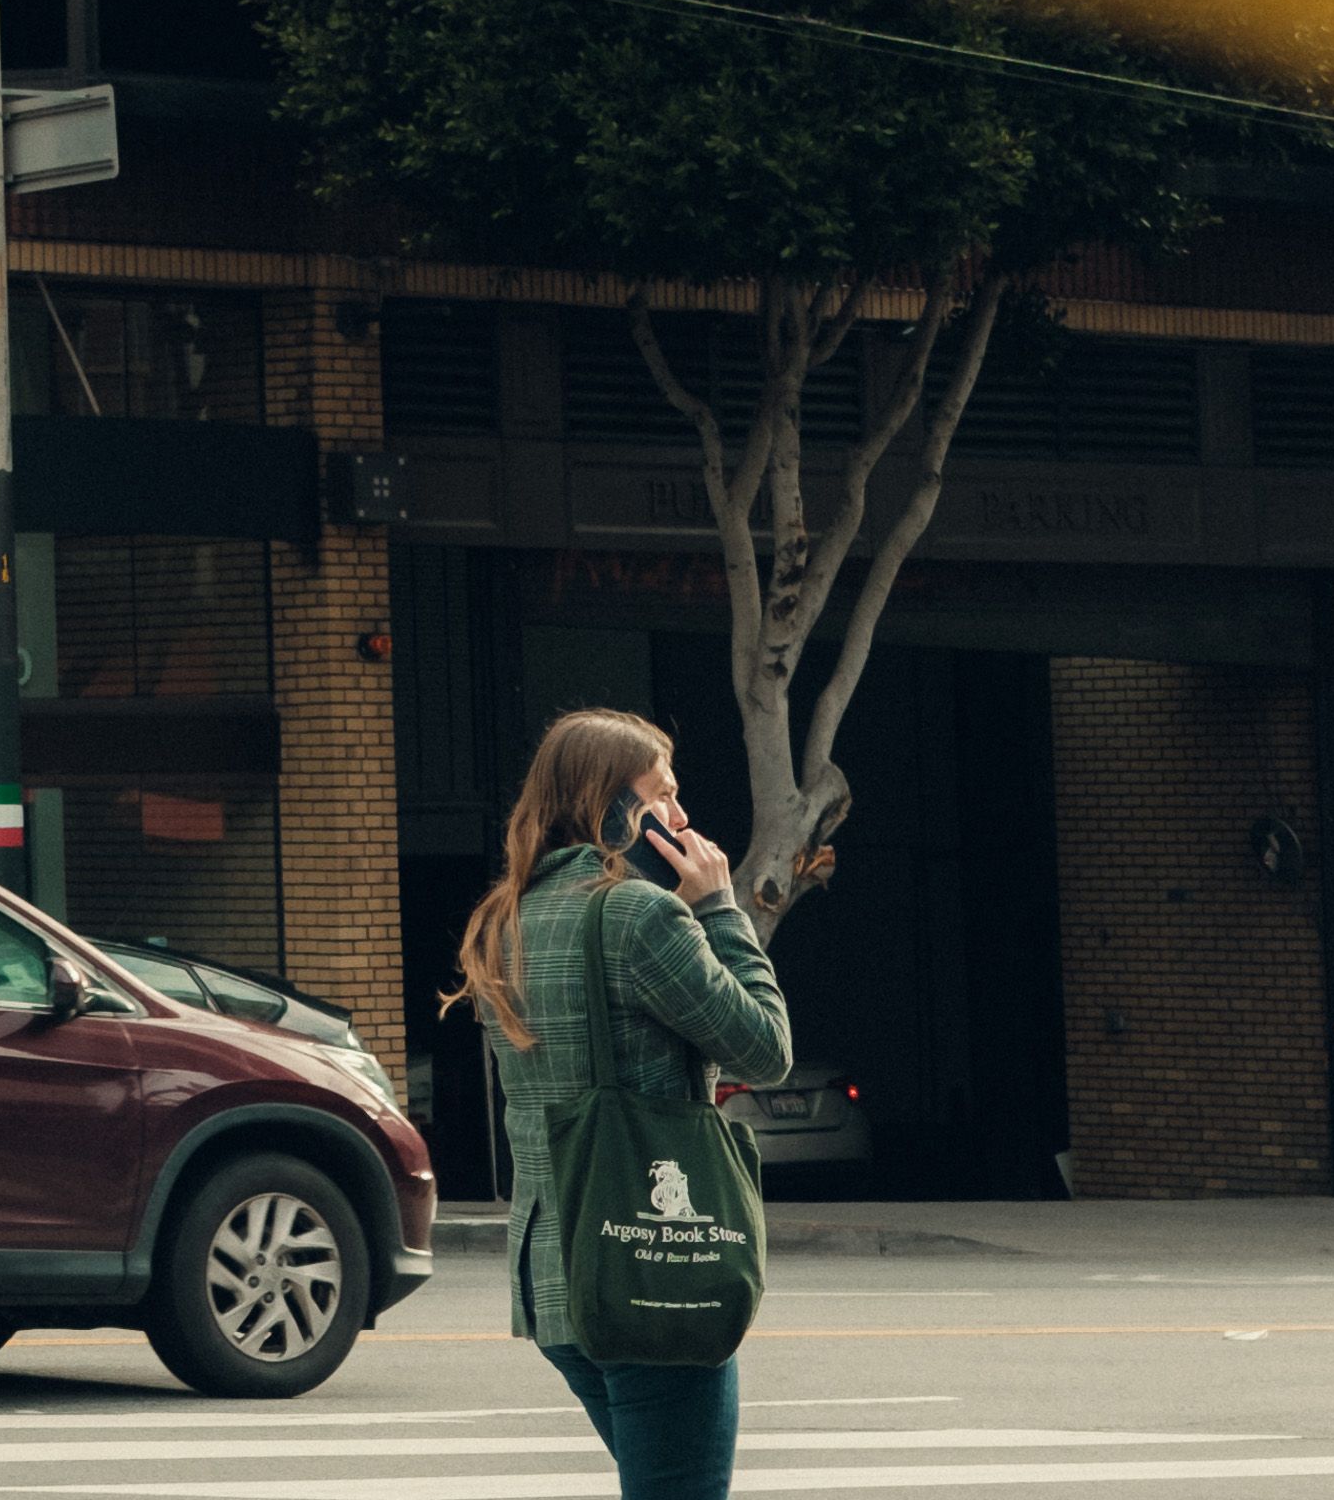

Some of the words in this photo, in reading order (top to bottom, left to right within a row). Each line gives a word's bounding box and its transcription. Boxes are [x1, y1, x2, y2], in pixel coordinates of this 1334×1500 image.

[979, 489, 1150, 534] PARKING
[600, 1220, 657, 1246] Argosy
[661, 1226, 706, 1243] Book
[708, 1226, 747, 1245] Store
[634, 1248, 652, 1261] Old
[653, 1251, 664, 1263] &
[692, 1251, 721, 1263] Books
